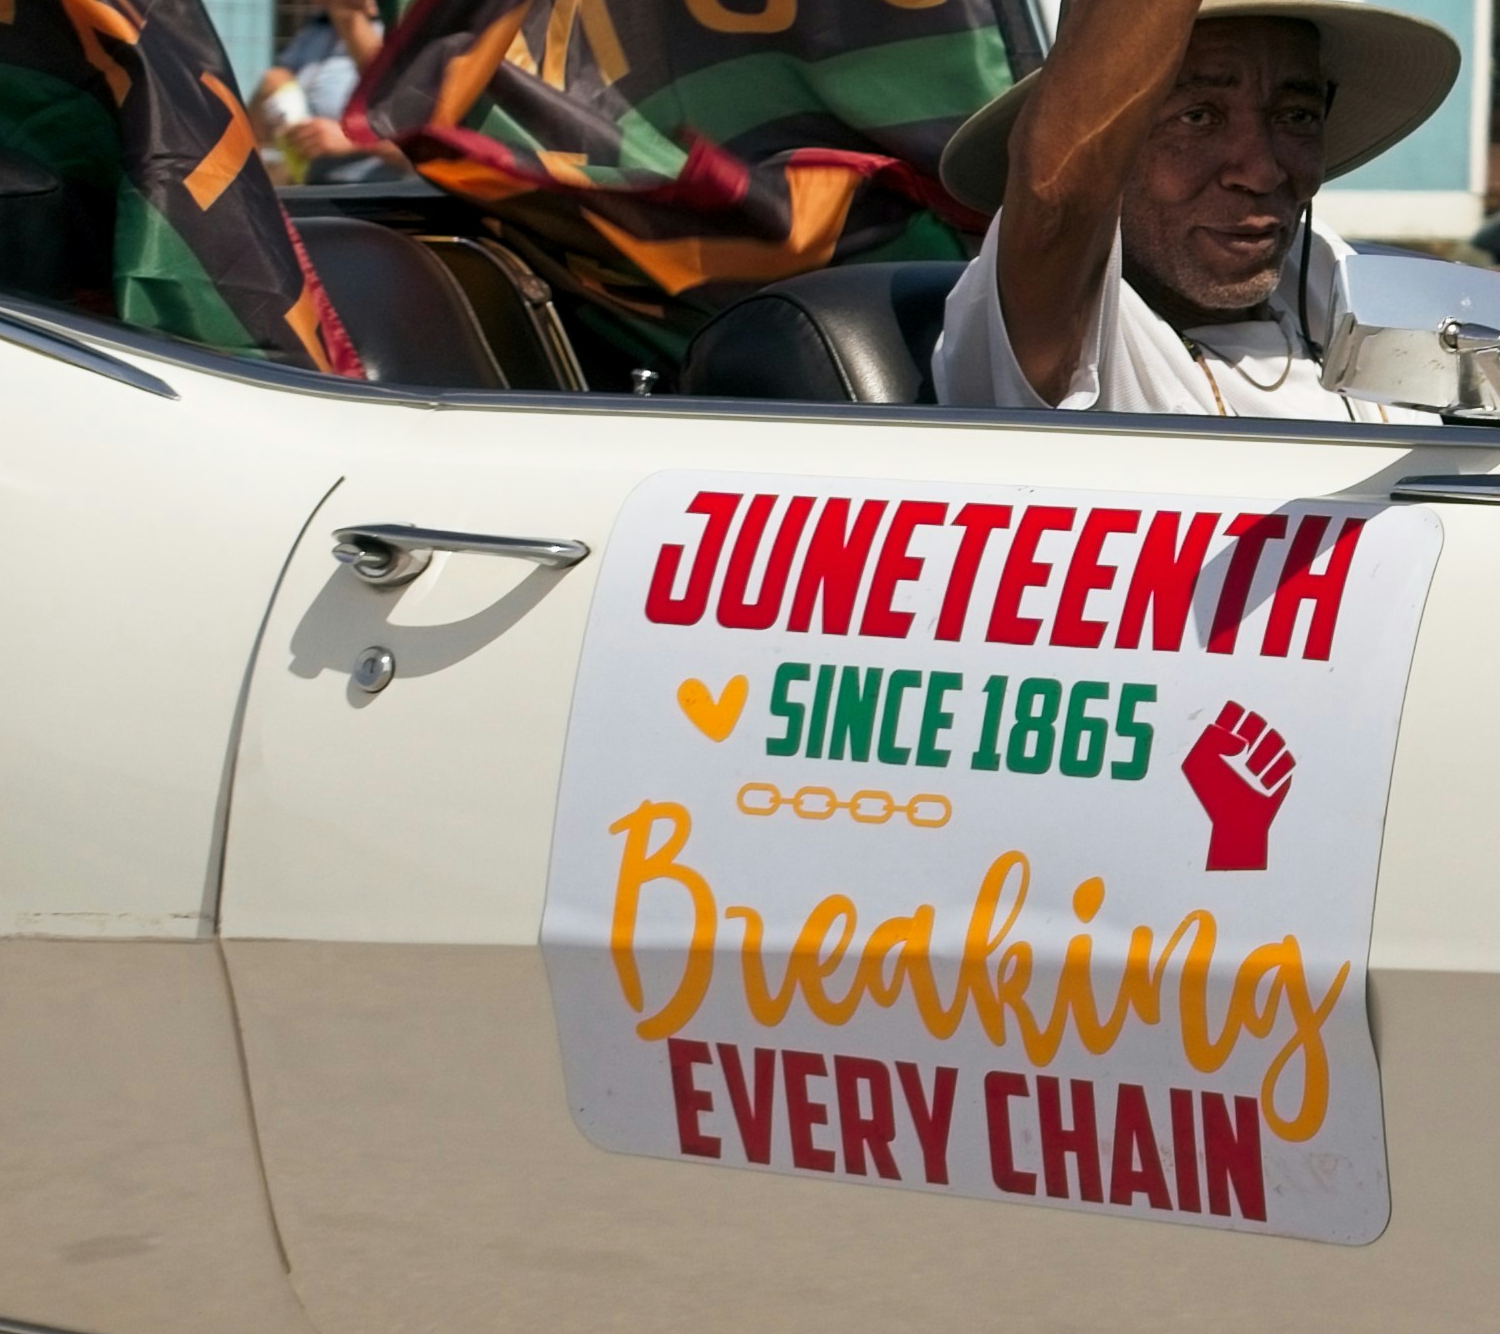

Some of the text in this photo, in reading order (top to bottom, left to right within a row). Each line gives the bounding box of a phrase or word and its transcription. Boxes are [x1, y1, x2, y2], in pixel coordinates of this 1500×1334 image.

[644, 490, 1366, 662] JUNETEENTH
[764, 661, 1159, 781] SINCE 1865
[608, 797, 1351, 1143] Breaking
[667, 1038, 1269, 1223] EVERY CHAIN
